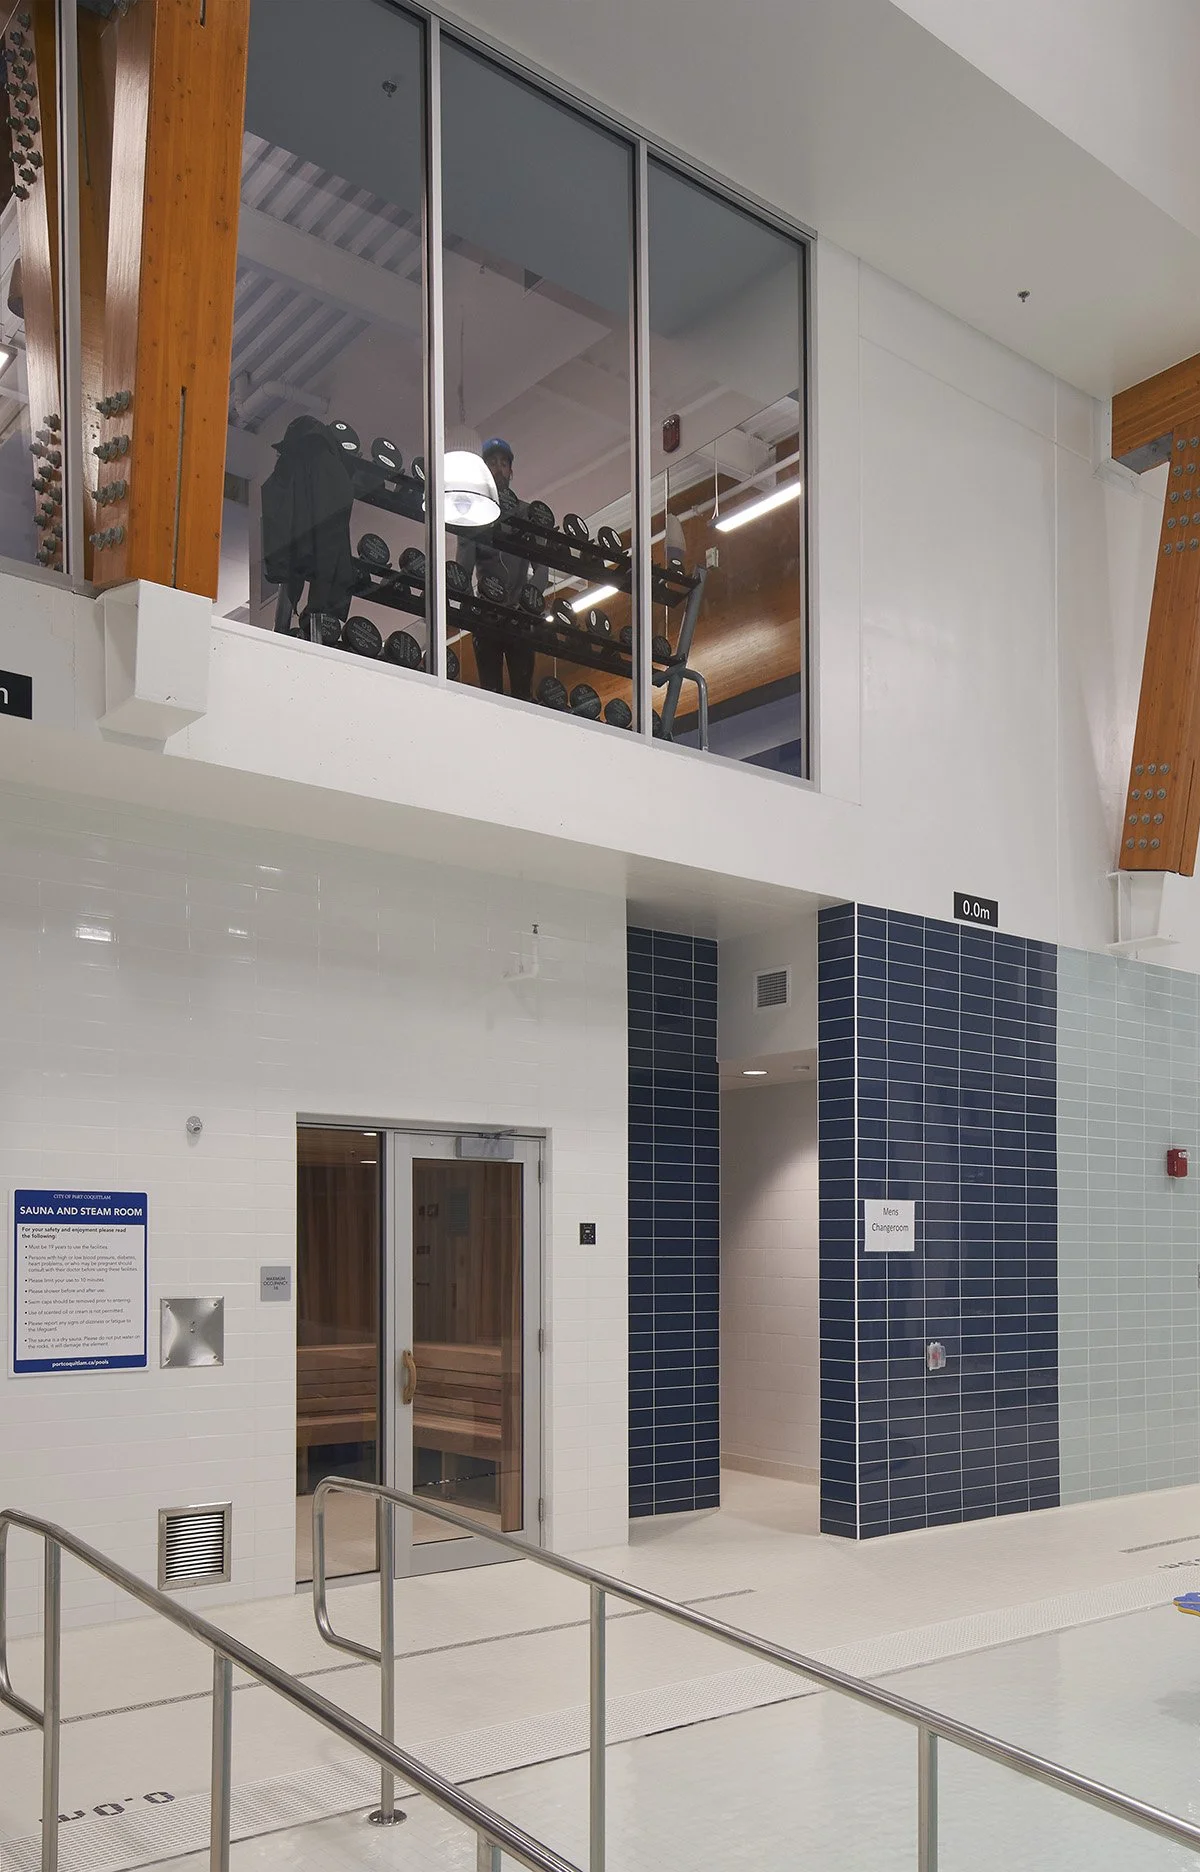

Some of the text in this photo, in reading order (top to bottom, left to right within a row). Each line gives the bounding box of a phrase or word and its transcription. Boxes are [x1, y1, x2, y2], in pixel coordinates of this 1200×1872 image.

[962, 899, 990, 920] 0.0m
[20, 1206, 143, 1217] SAUNA AND STEAM ROOM
[882, 1207, 899, 1216] Mens
[871, 1222, 909, 1234] Changeroom
